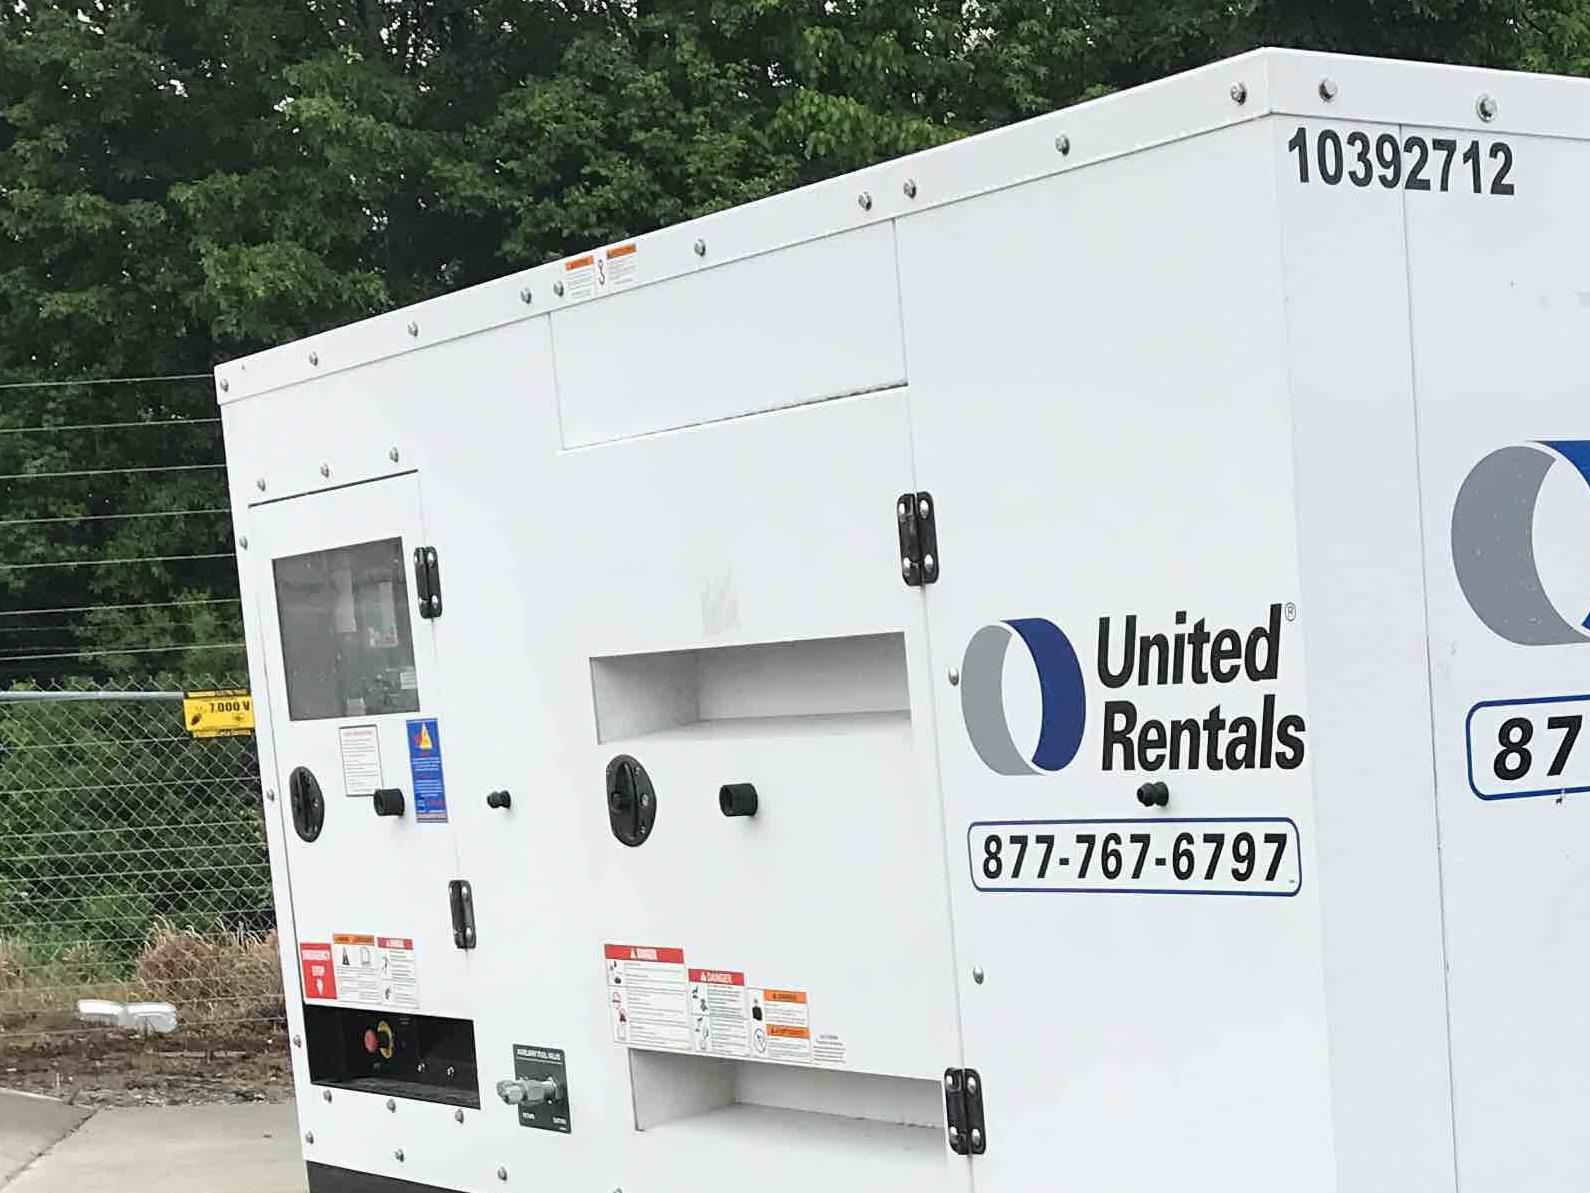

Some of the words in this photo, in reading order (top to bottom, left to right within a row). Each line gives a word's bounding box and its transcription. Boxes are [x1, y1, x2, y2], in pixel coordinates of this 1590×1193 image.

[1289, 127, 1515, 195] 10392712
[1098, 604, 1282, 688] United
[1102, 694, 1305, 771] Rentals
[983, 832, 1287, 881] 877-767-6797
